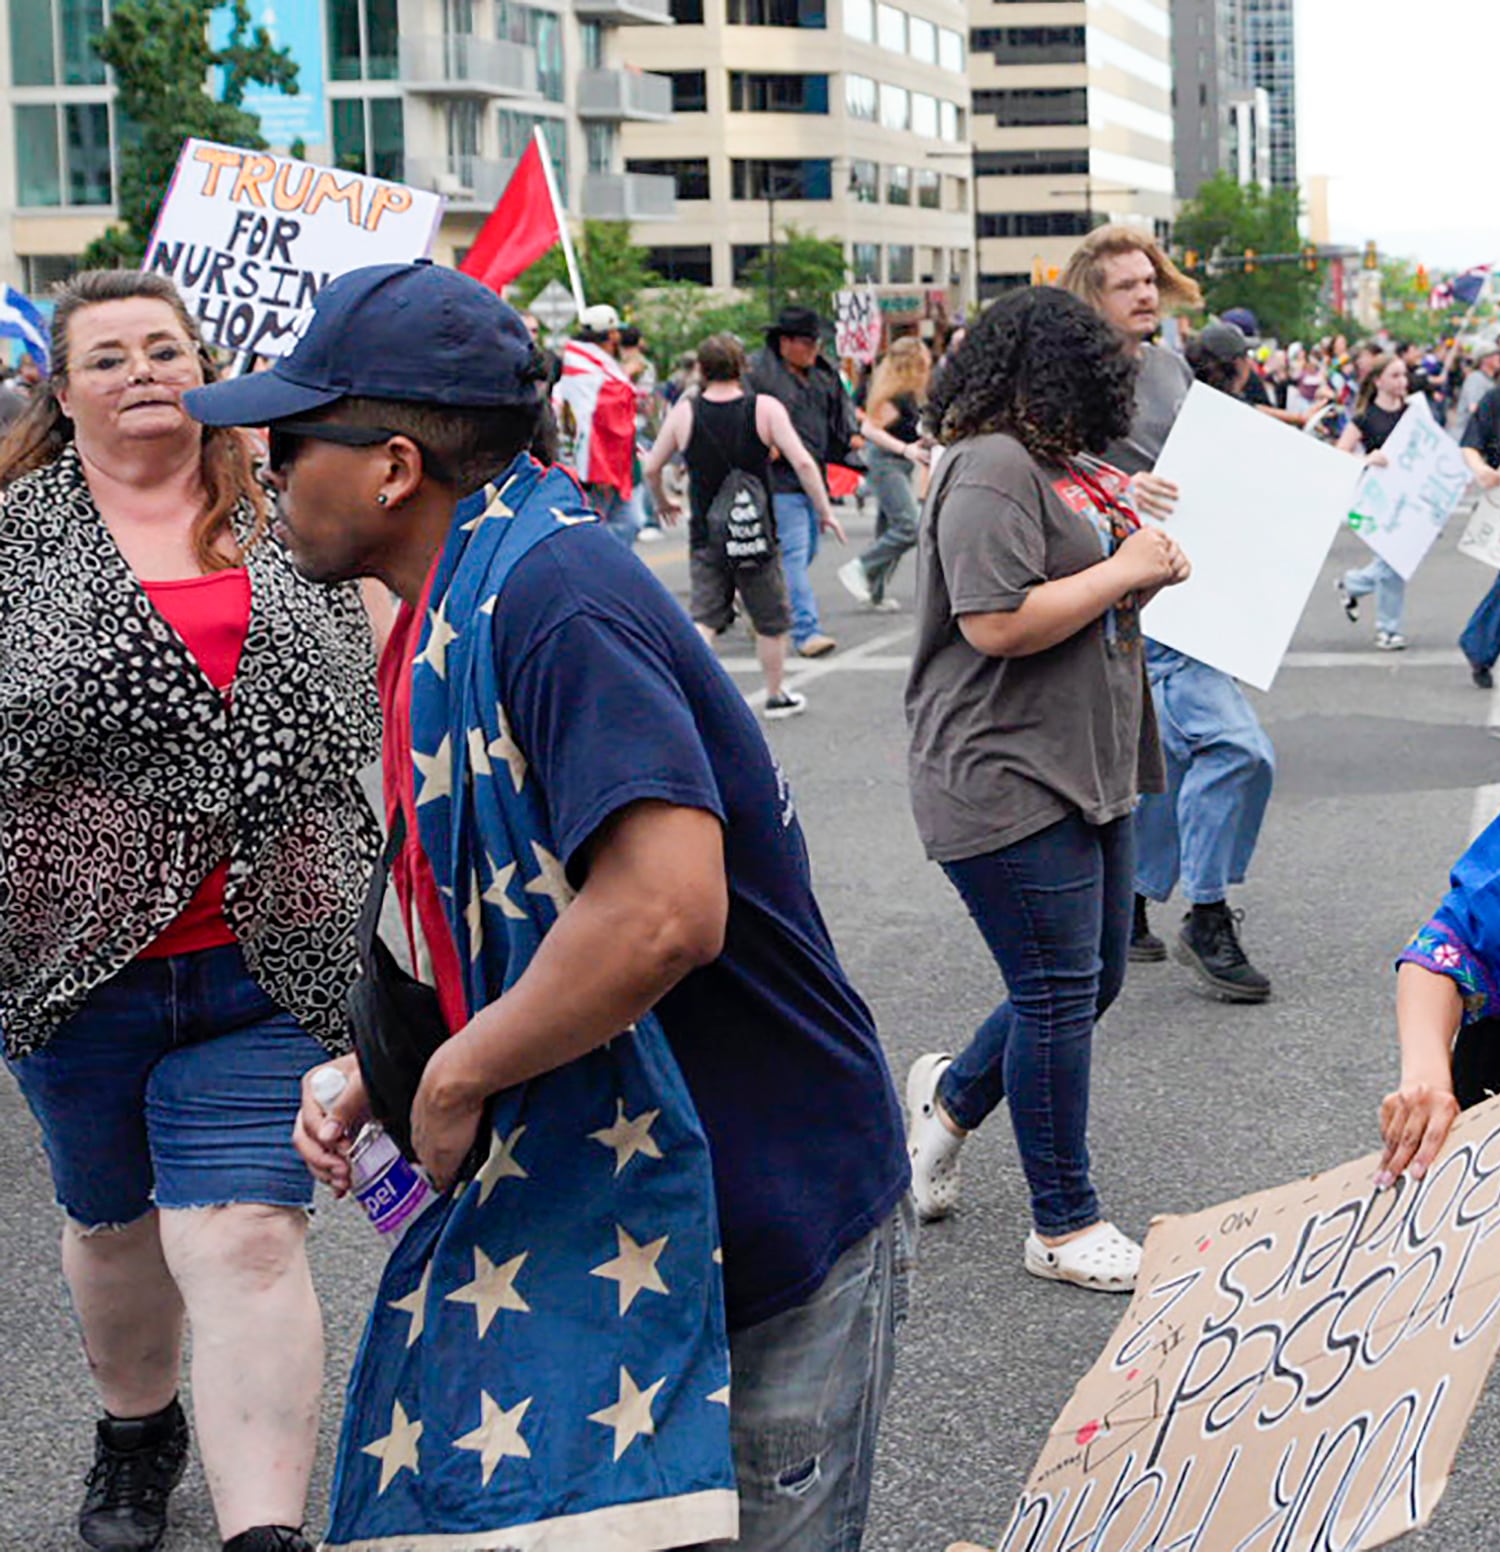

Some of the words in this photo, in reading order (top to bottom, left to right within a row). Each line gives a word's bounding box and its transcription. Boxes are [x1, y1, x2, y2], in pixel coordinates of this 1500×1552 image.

[193, 148, 413, 231] TRUMP
[226, 210, 300, 264] FOR
[150, 241, 330, 310] NURSIN
[196, 298, 301, 350] HOM
